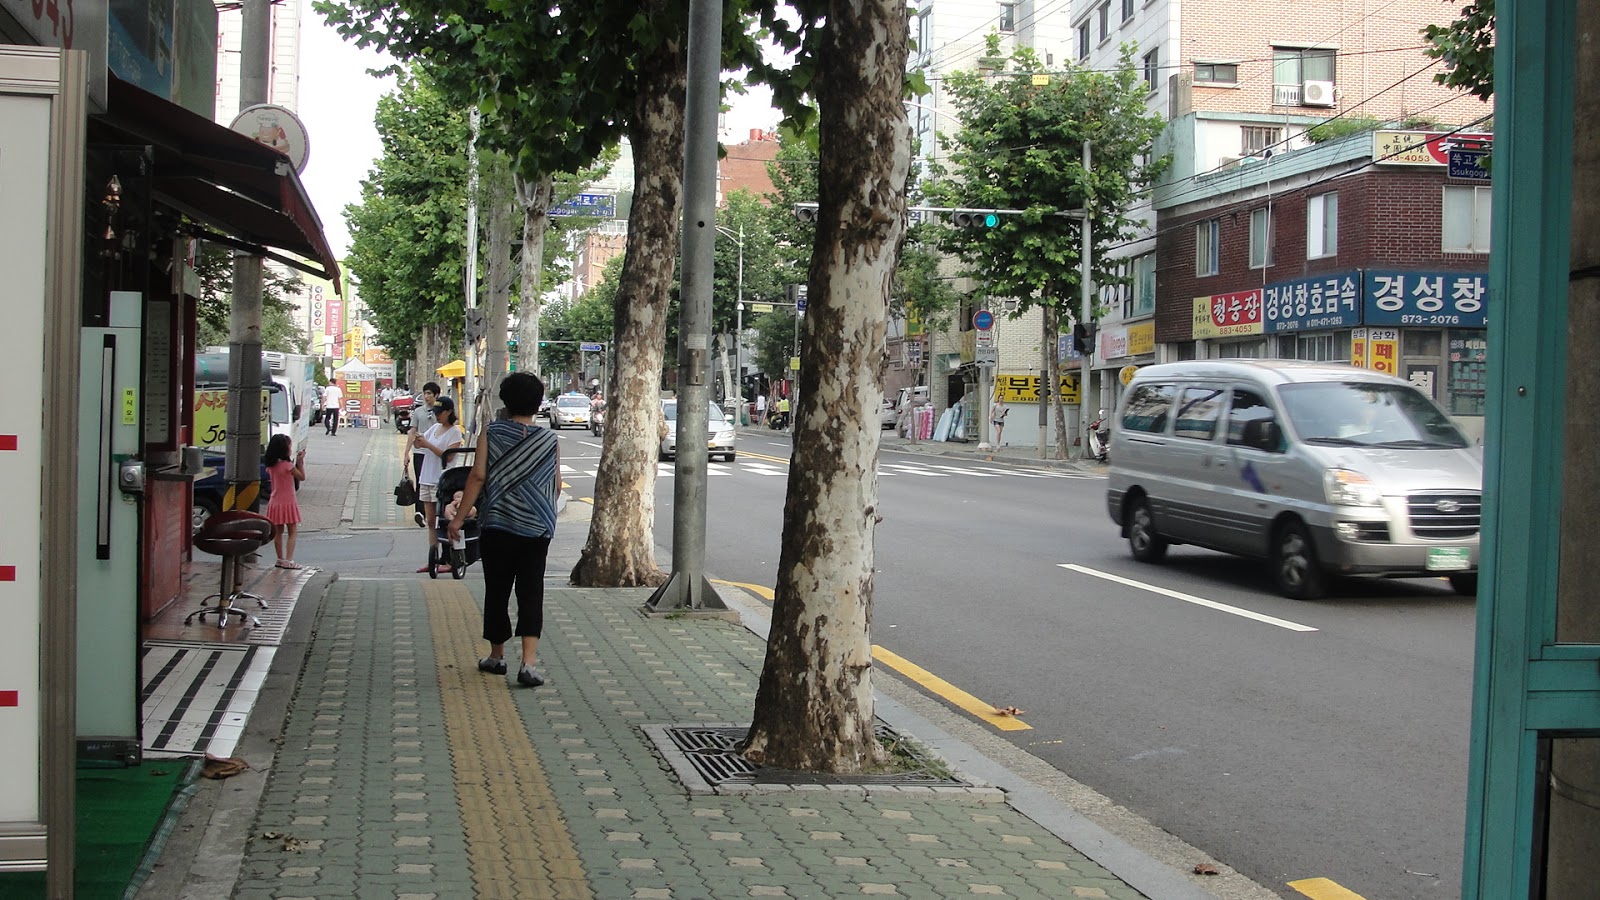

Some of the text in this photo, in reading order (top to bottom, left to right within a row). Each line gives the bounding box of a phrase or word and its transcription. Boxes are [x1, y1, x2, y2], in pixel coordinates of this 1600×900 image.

[1266, 277, 1356, 321] 경성창호금속
[1401, 315, 1459, 324] 873-2076
[1219, 325, 1252, 335] 883-4053
[1276, 320, 1299, 330] 873-2076
[1372, 331, 1395, 340] 삼화
